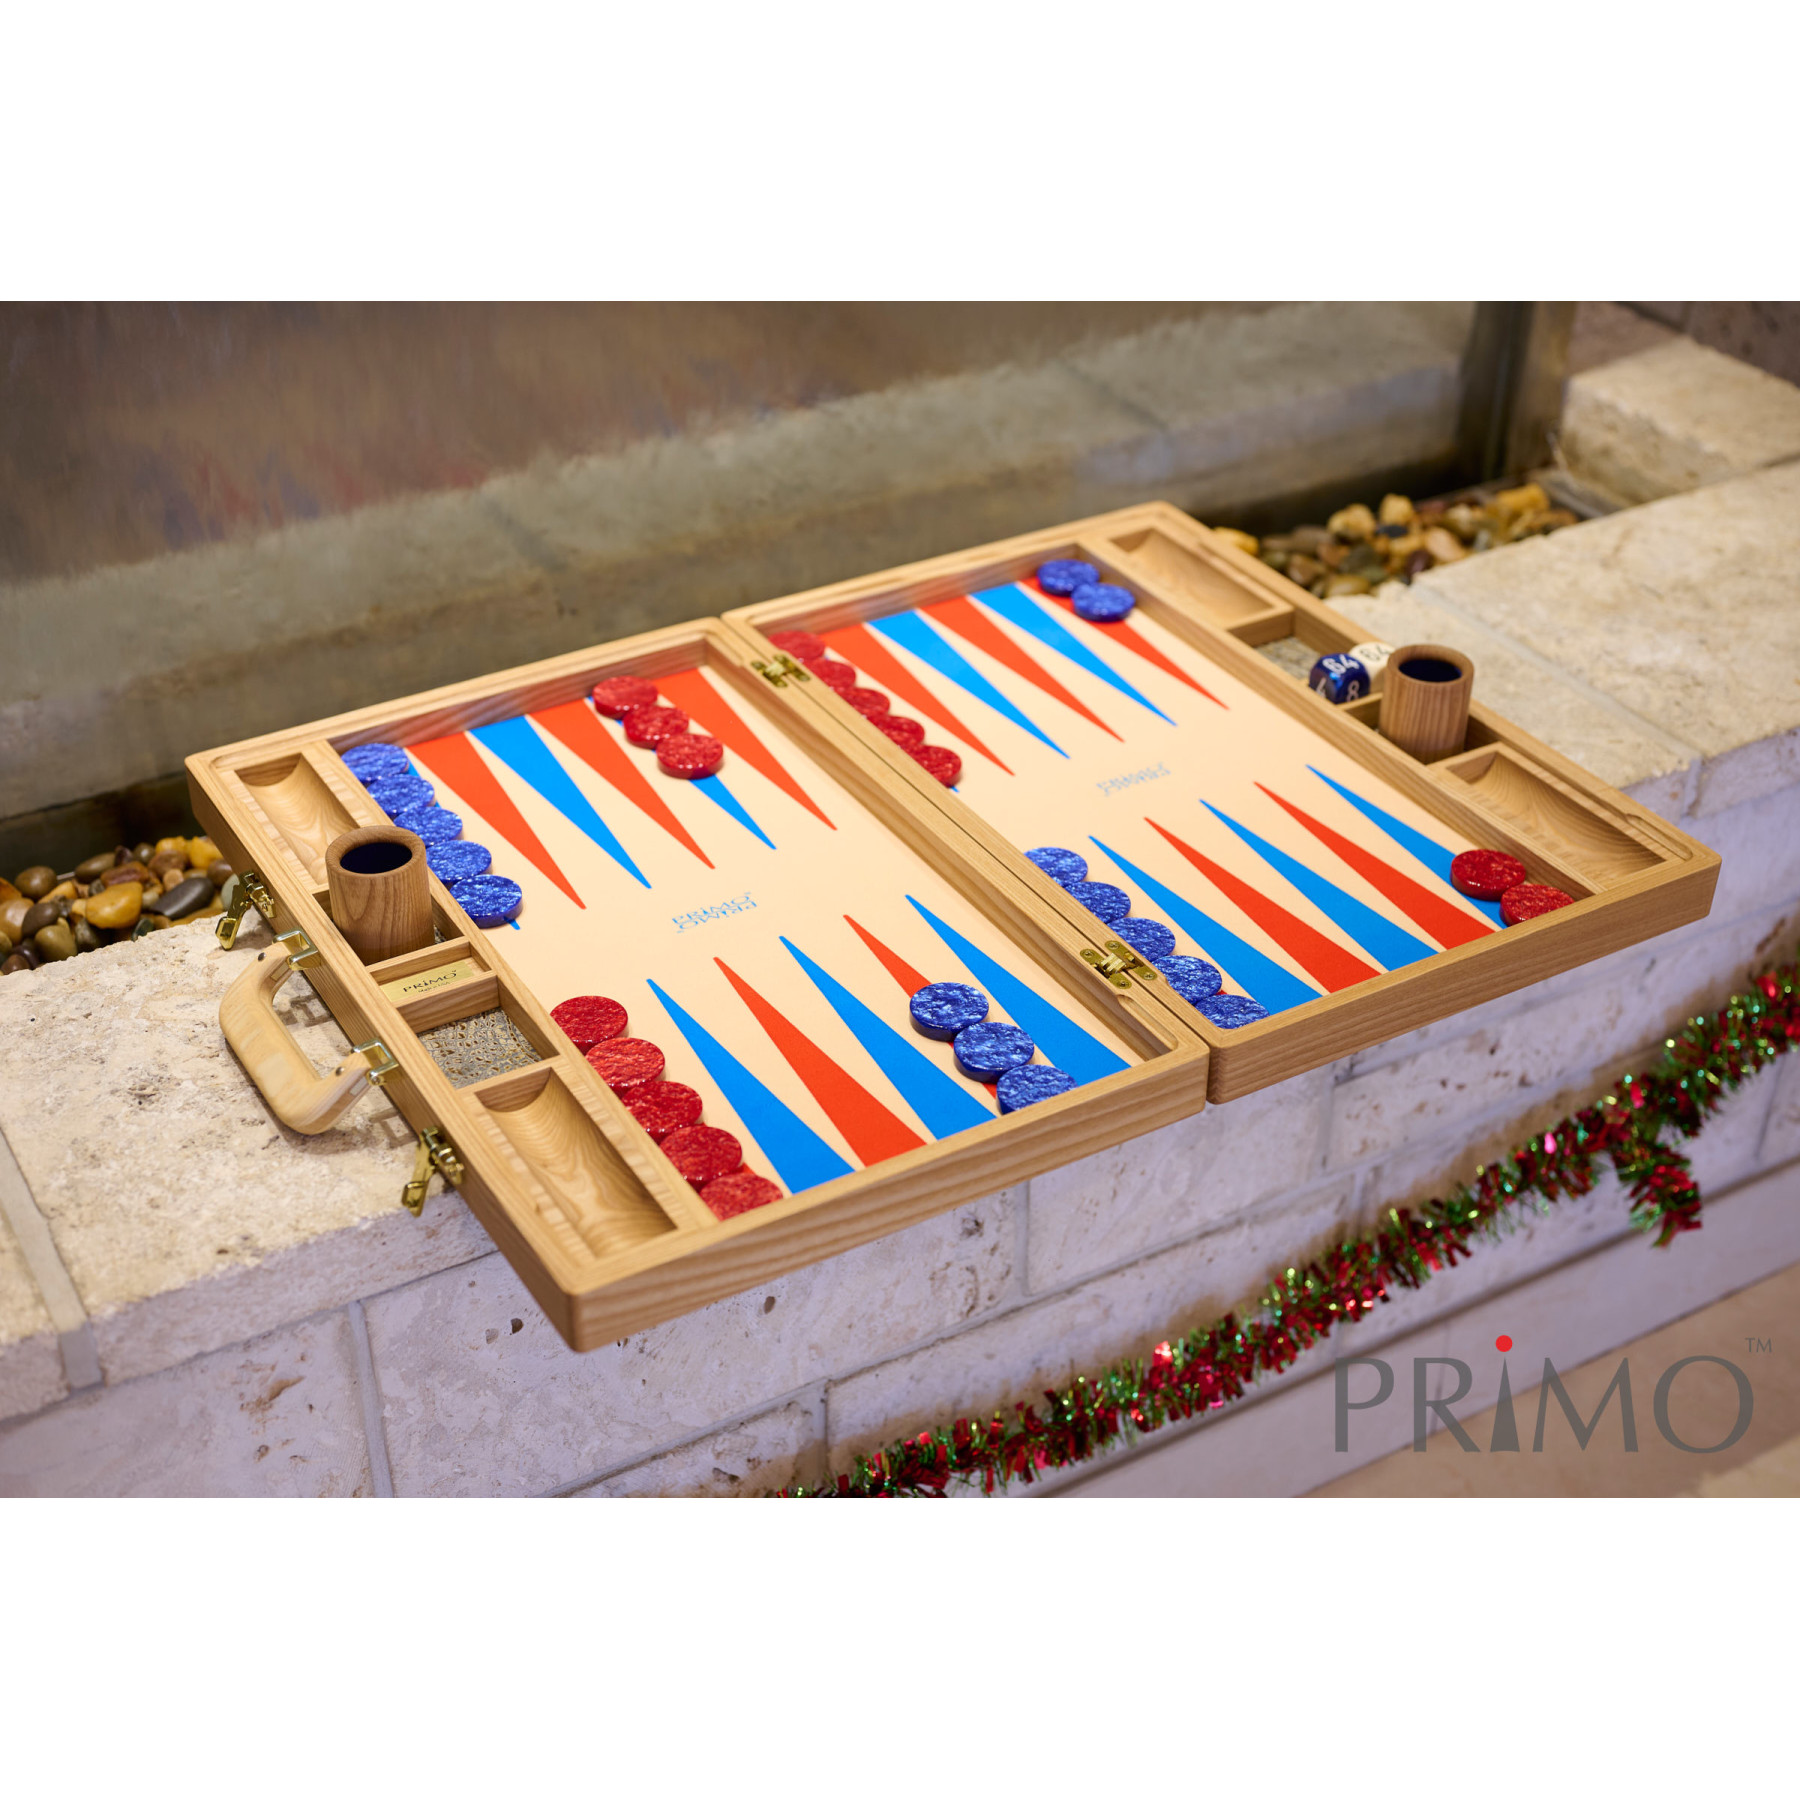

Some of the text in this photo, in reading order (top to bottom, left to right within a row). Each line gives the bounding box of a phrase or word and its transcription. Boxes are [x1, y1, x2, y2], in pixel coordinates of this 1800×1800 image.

[1360, 645, 1391, 661] 64
[1322, 654, 1360, 674] 64
[1345, 680, 1360, 703] 8
